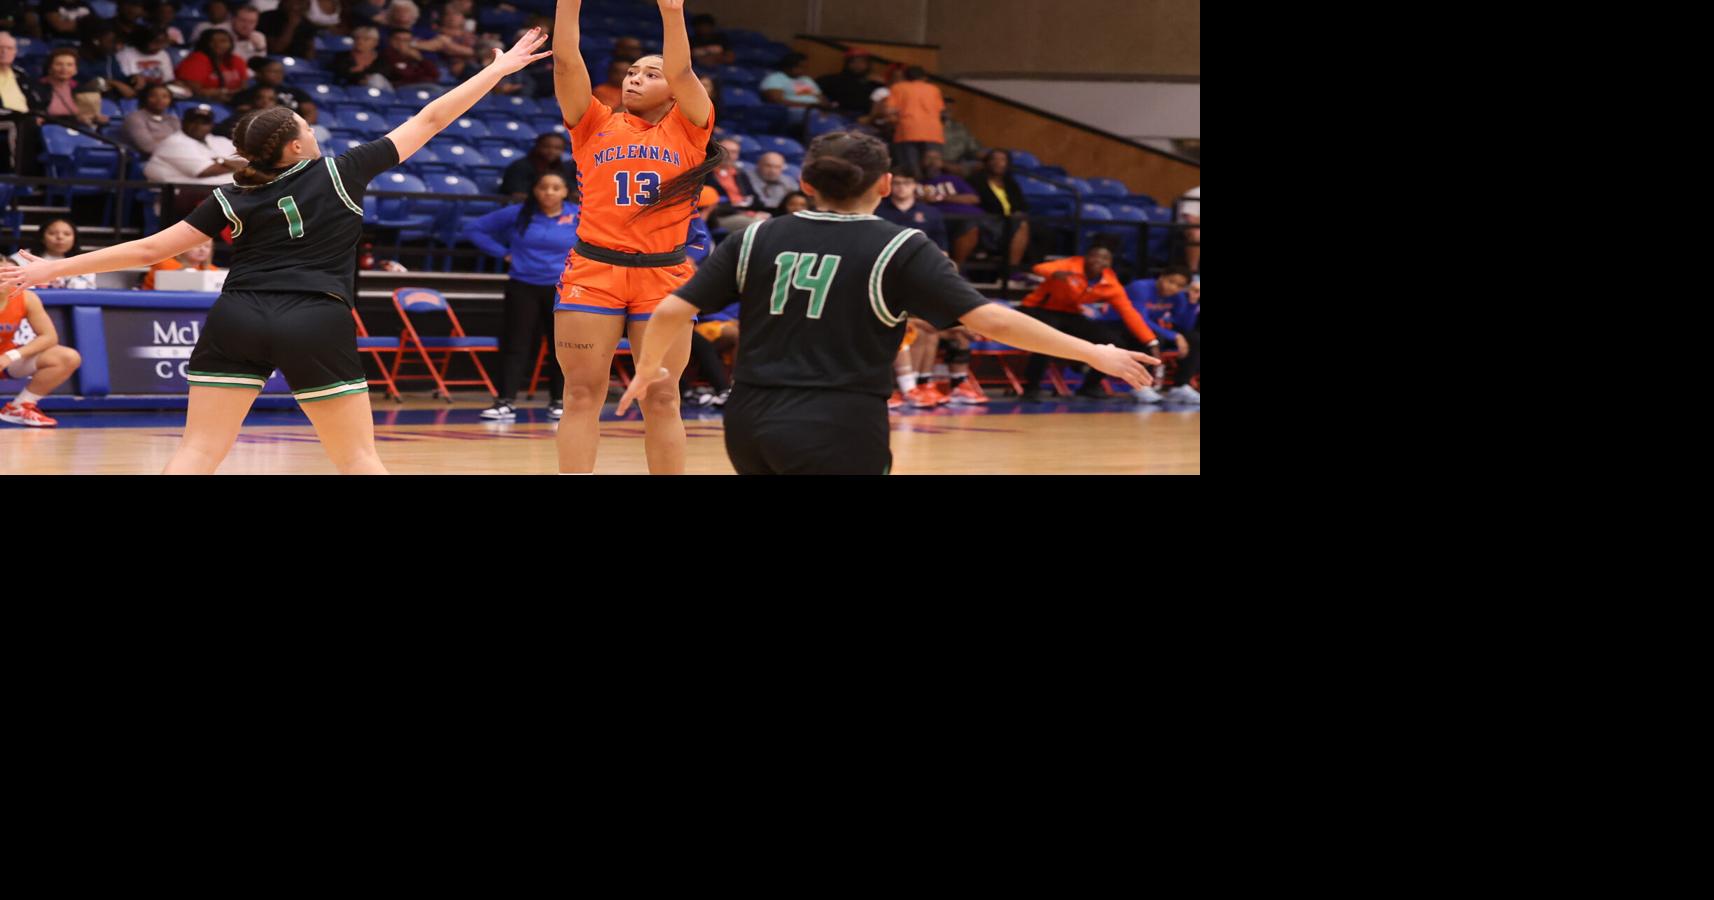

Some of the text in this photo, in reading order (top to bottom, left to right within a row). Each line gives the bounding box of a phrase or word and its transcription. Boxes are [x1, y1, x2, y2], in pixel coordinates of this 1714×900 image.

[614, 171, 660, 206] 13
[278, 196, 304, 239] 1
[770, 251, 841, 319] 14
